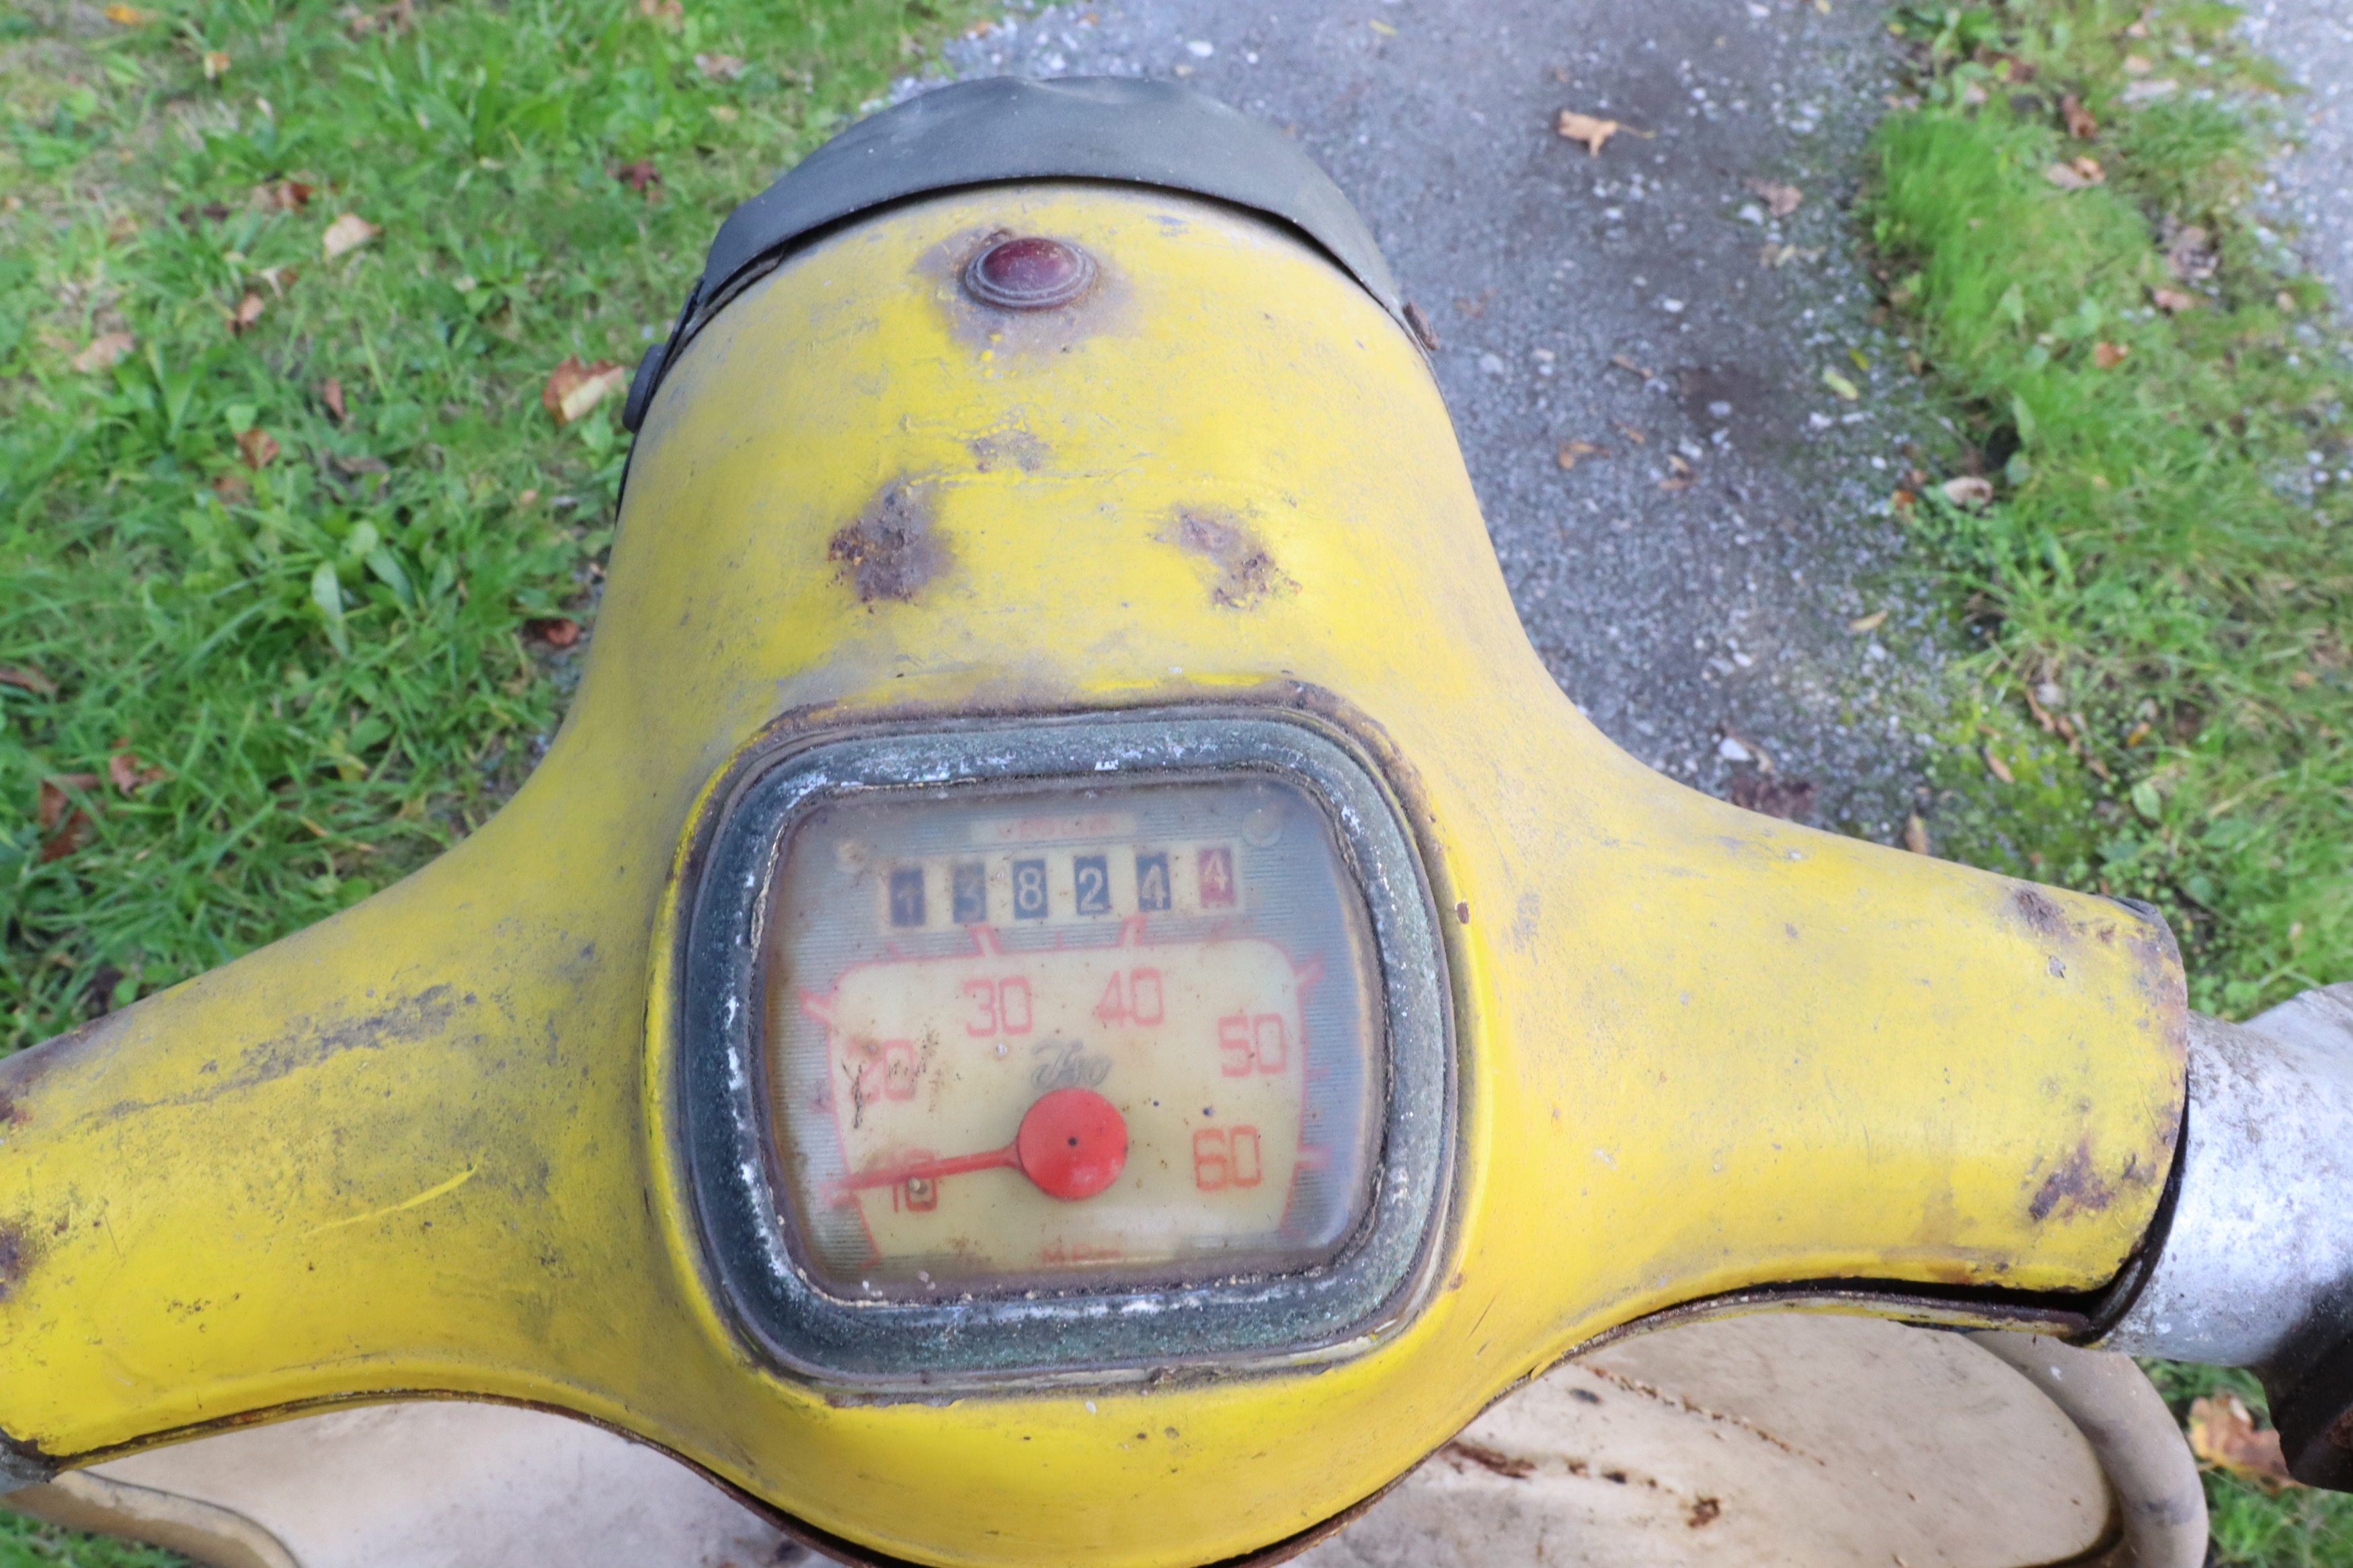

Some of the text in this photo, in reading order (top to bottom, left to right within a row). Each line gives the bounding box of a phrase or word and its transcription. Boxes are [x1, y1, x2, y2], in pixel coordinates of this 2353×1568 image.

[964, 977, 1033, 1036] 30
[1097, 968, 1166, 1028] 40
[847, 1038, 917, 1102] 20
[1220, 1014, 1287, 1077] 50
[1193, 1126, 1261, 1192] 60
